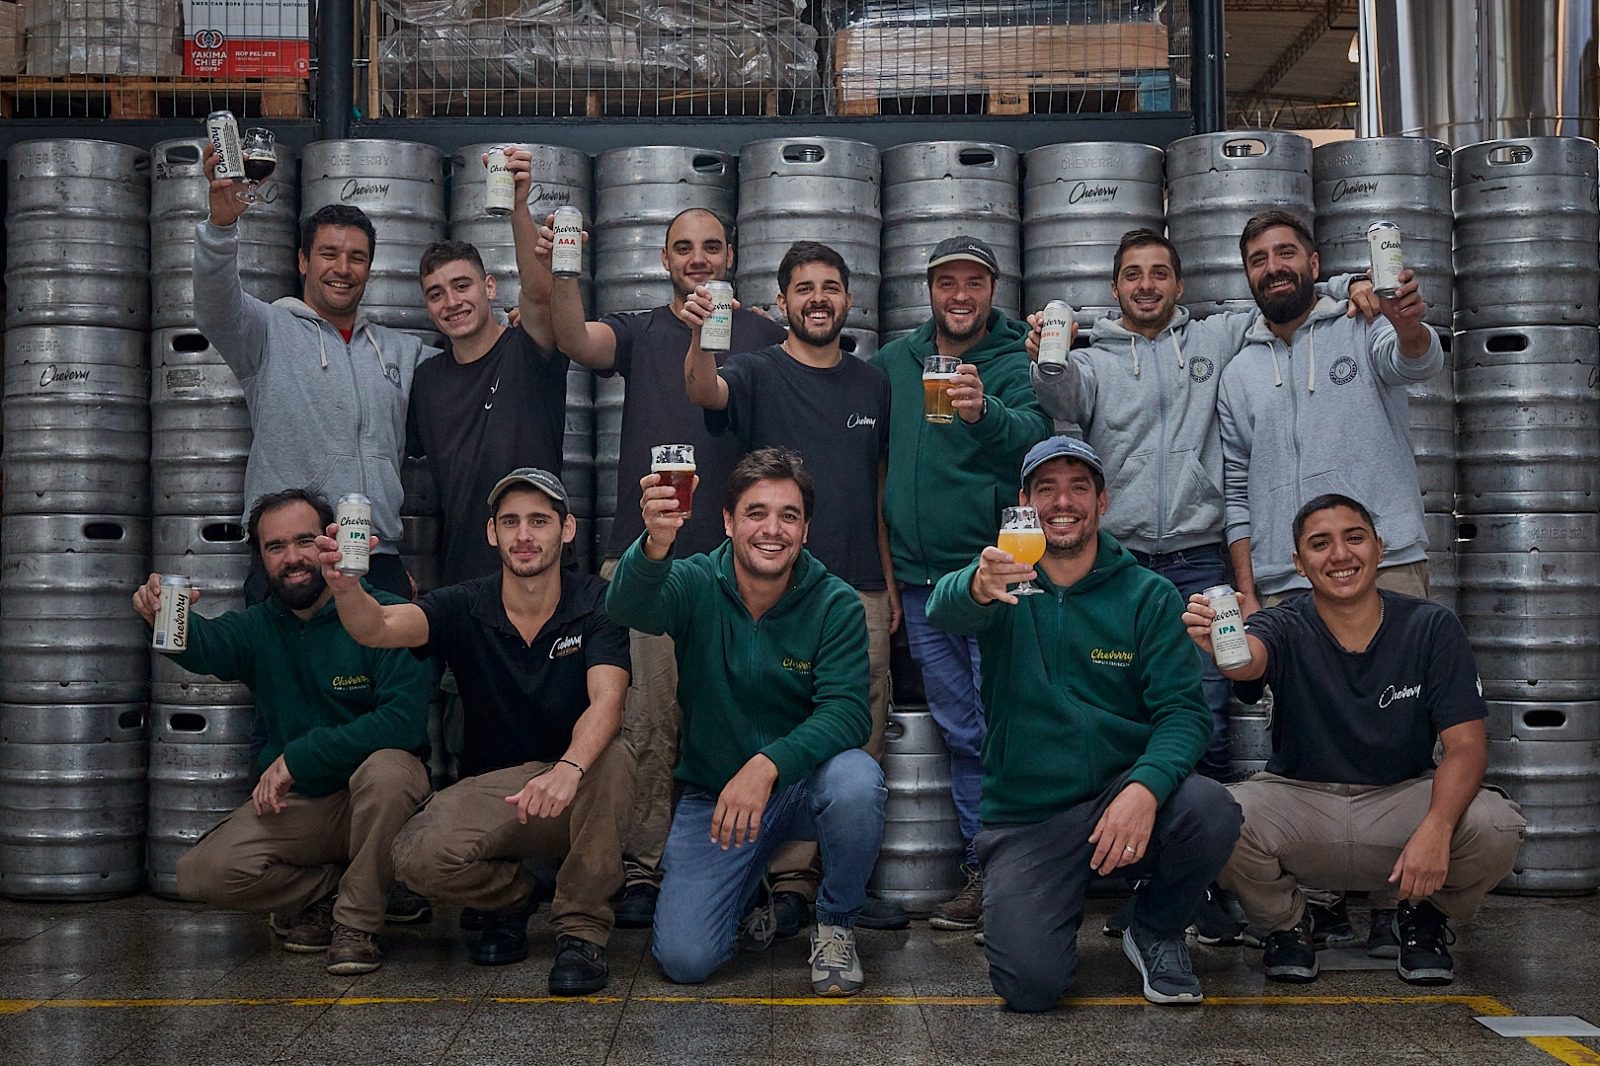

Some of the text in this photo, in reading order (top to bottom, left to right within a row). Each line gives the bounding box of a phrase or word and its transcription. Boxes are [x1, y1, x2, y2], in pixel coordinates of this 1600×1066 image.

[192, 51, 227, 59] YAKIMA
[330, 154, 390, 166] CHEERRY
[1062, 158, 1120, 169] CHEVERRY
[341, 179, 390, 201] Cheverry
[1069, 182, 1118, 204] Cheverry
[1332, 180, 1378, 203] Cheverry
[558, 238, 576, 246] AAA
[40, 364, 90, 387] Cheverry
[350, 531, 366, 541] IPA
[173, 593, 188, 648] Cheverry
[1219, 625, 1236, 635] IPA
[1091, 648, 1134, 663] Cheverry
